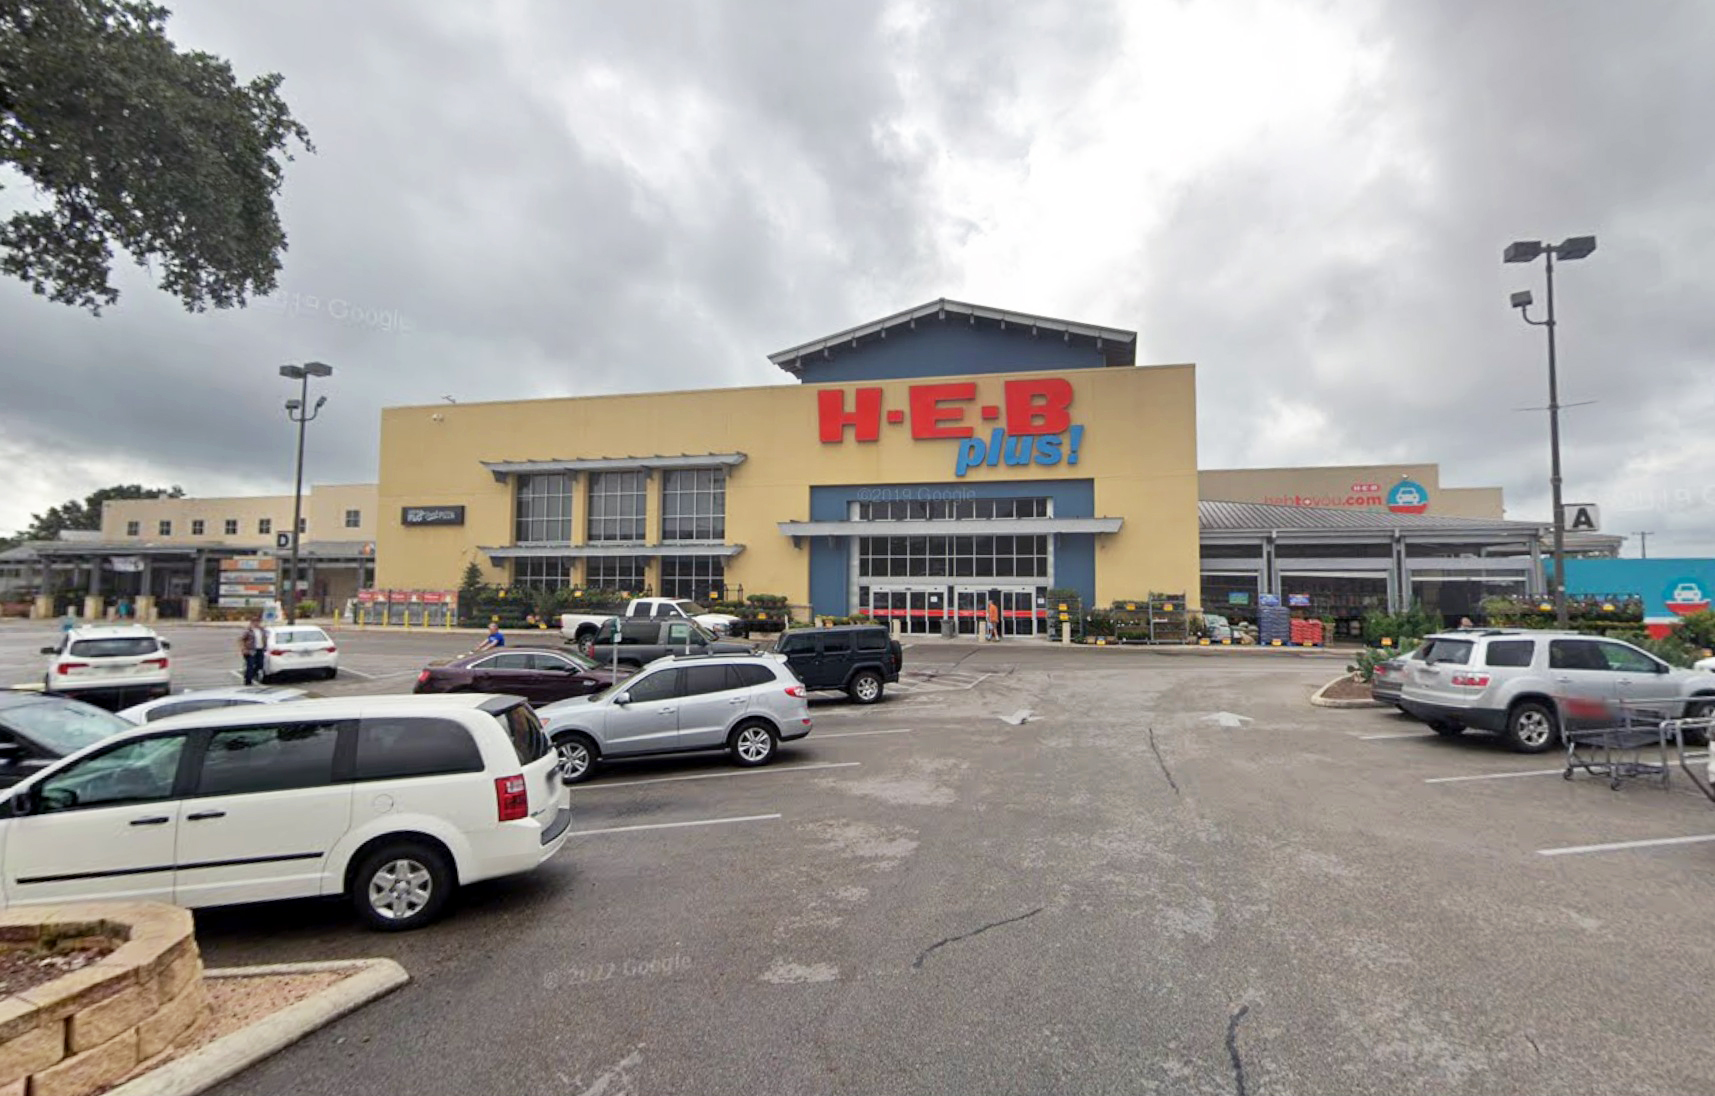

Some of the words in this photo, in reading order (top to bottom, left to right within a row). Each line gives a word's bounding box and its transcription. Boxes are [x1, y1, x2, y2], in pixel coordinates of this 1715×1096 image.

[955, 424, 1084, 477] plus!
[1572, 507, 1596, 528] A
[277, 533, 290, 548] D
